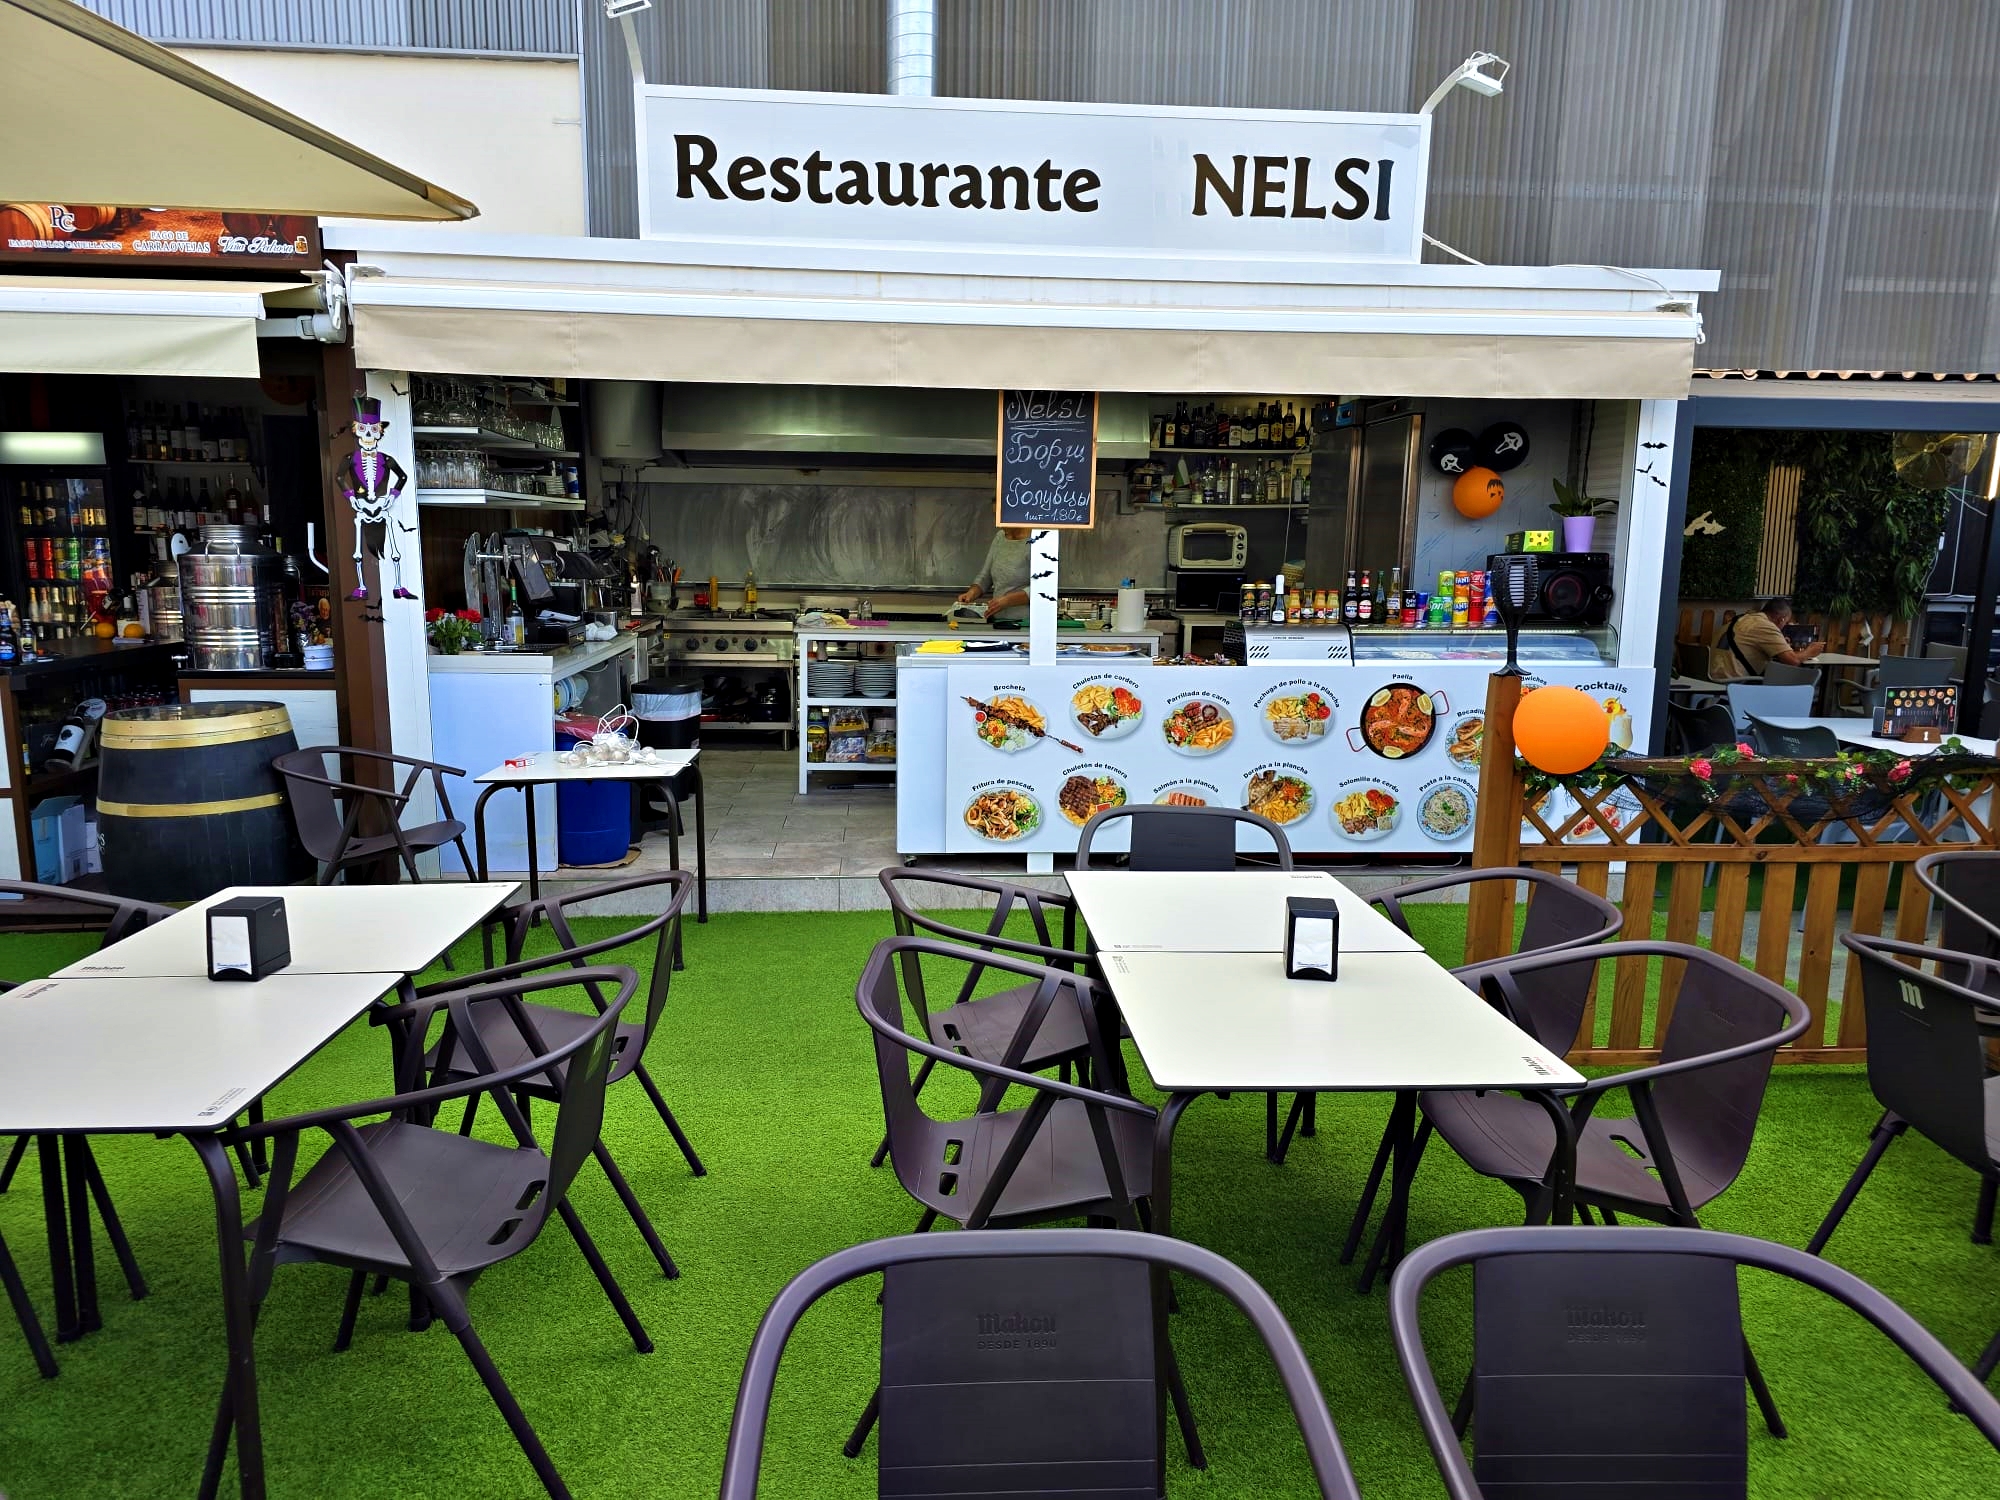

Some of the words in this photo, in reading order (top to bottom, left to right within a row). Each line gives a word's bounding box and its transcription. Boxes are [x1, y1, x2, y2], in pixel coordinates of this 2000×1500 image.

[674, 135, 1100, 212] Restaurante
[1193, 154, 1394, 220] NELSI
[150, 231, 174, 240] PAGO
[175, 231, 188, 240] DE
[133, 240, 210, 253] CARRAOVEJAS
[1006, 390, 1087, 420] Nelsi
[1006, 430, 1085, 469] Борщ
[1006, 478, 1090, 510] Голубцы
[993, 684, 1026, 692] Brocheta
[1072, 674, 1102, 690] Chuletas
[1114, 674, 1139, 689] cordero
[1575, 681, 1628, 694] Cocktails
[1166, 690, 1200, 705] Parrillada
[1212, 693, 1230, 706] carne
[1253, 684, 1278, 708] Pechuga
[1320, 684, 1340, 708] plancha
[1062, 763, 1093, 776] Chuletón
[1104, 763, 1128, 779] ternera
[1243, 763, 1267, 779] Dorada
[1282, 762, 1308, 775] plancha
[972, 780, 995, 792] Fritura
[1007, 779, 1035, 792] pescado
[1153, 780, 1178, 794] Salmón
[1193, 778, 1219, 794] plancha
[1339, 776, 1371, 788] Solomillo
[1382, 780, 1399, 793] cerdo
[1419, 778, 1437, 792] Pasta
